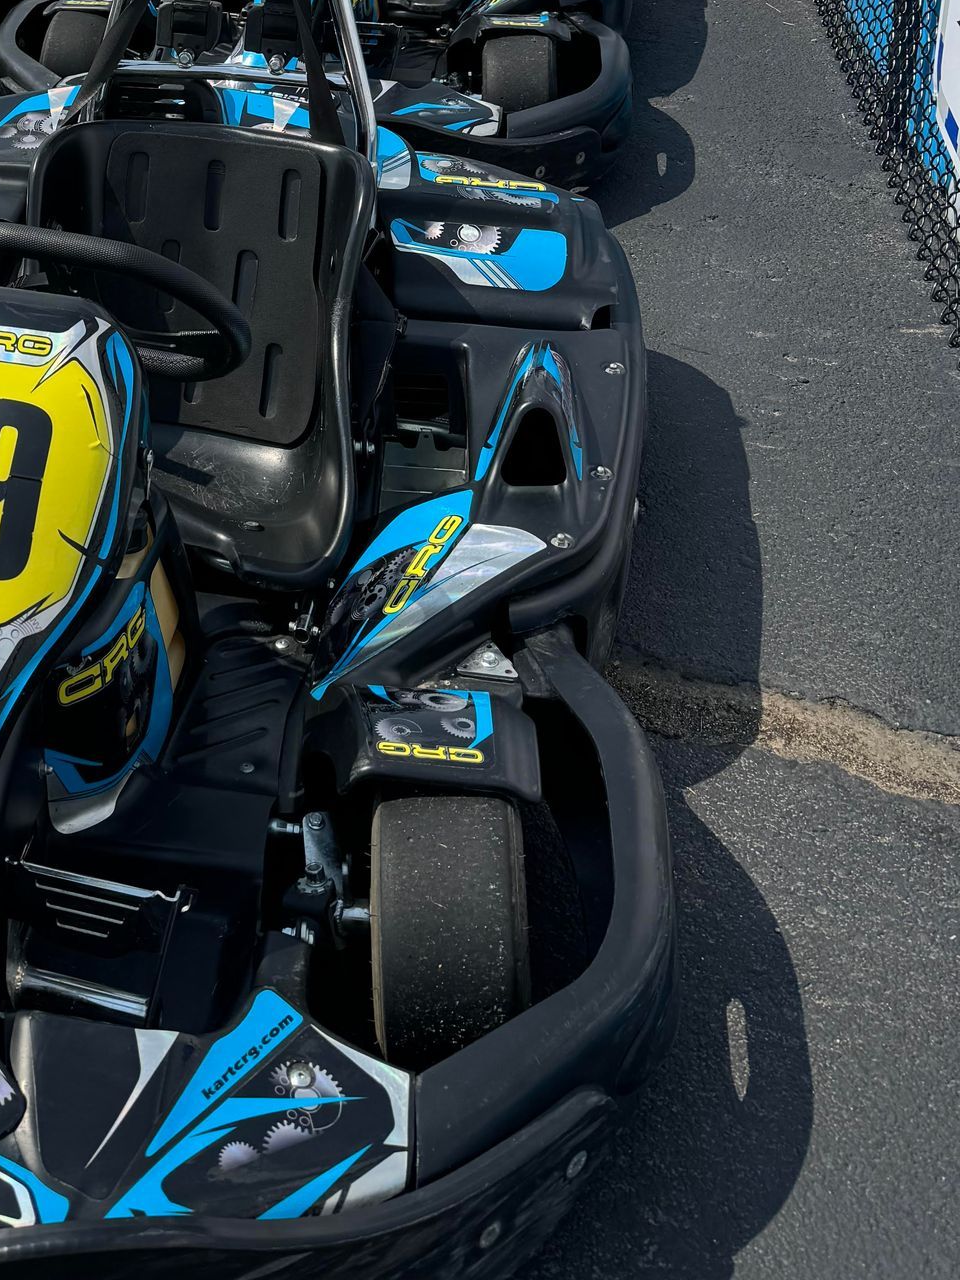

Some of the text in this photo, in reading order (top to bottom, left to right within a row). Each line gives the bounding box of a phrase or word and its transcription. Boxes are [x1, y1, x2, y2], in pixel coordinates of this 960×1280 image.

[382, 513, 465, 615] CRG
[57, 605, 146, 707] CRG
[376, 740, 485, 764] CRG
[200, 1013, 296, 1101] kartcrg.com
